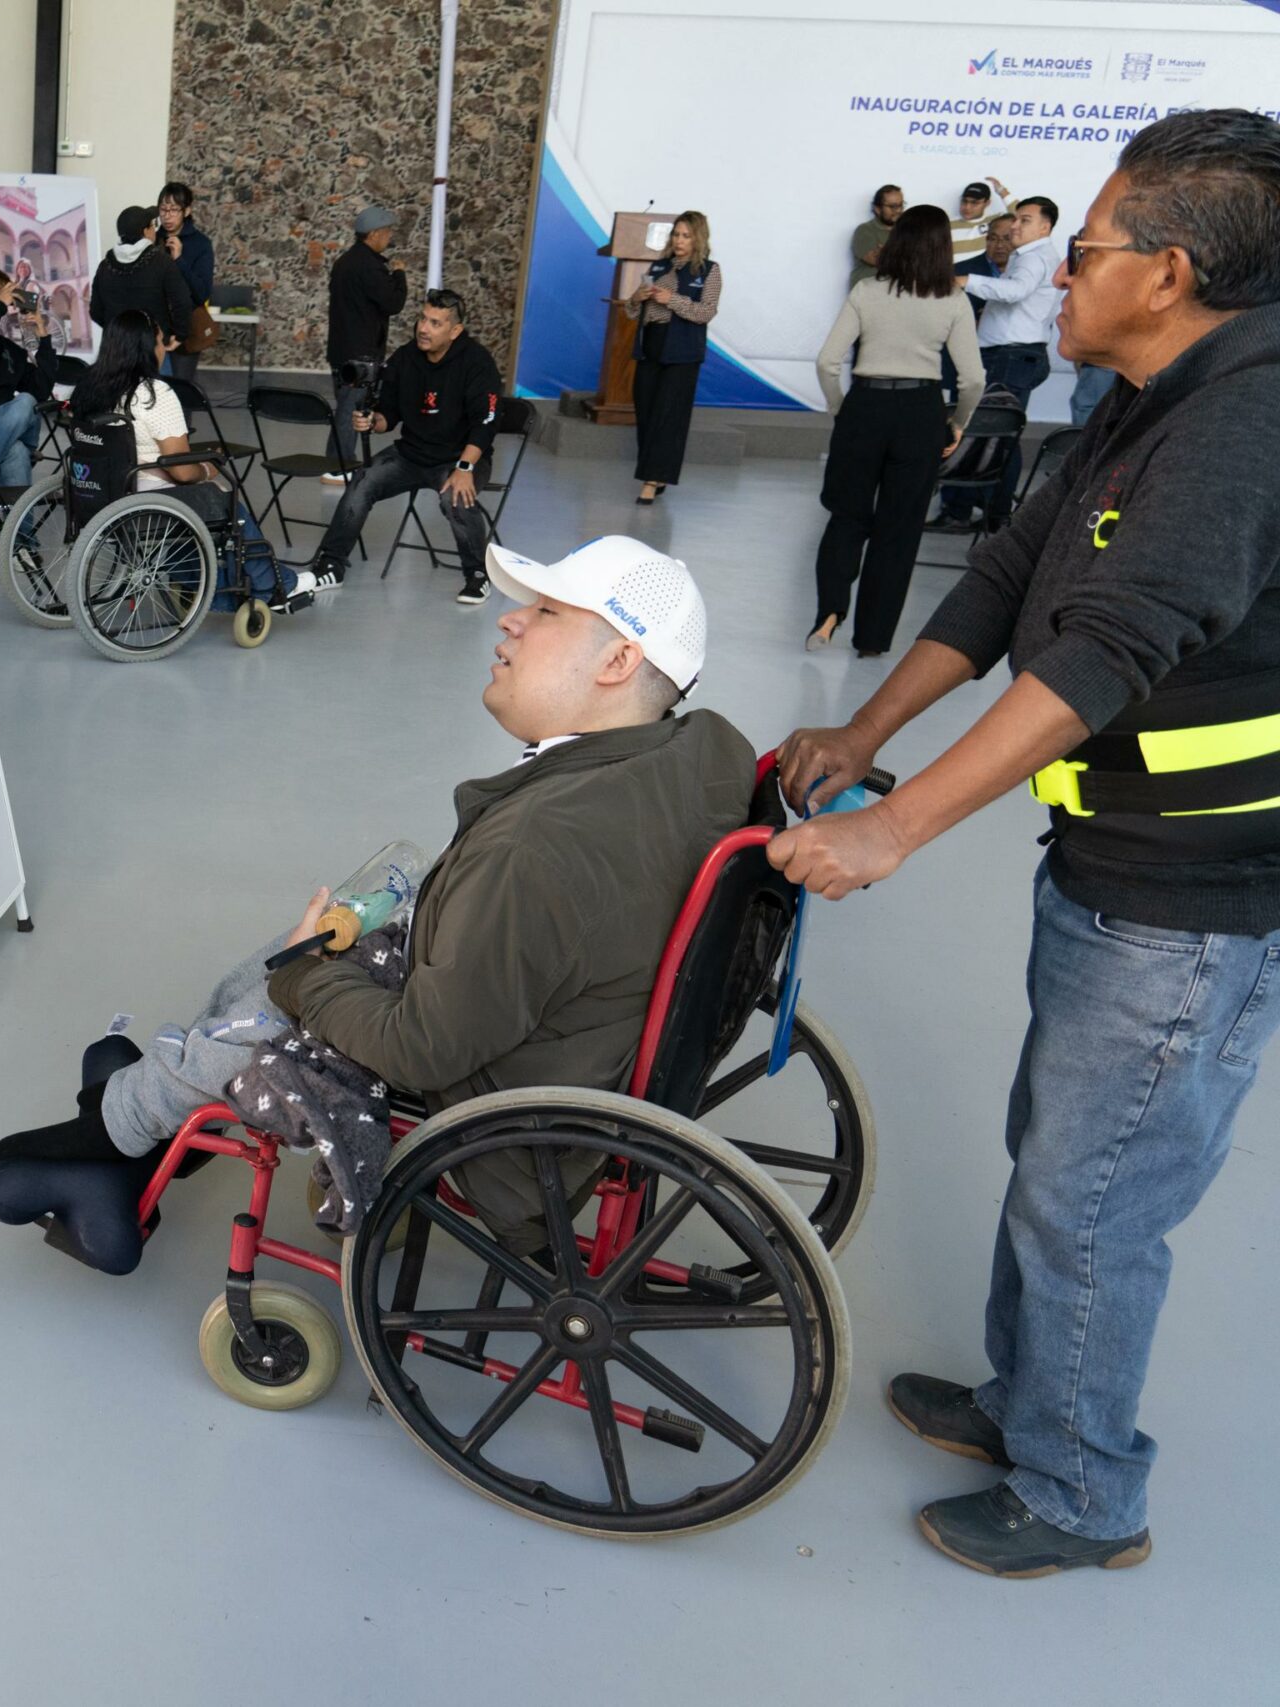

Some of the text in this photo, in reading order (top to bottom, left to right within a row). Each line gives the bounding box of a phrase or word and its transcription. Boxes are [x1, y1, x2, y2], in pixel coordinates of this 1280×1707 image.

[1002, 57, 1093, 70] EL MARQUÉS
[850, 96, 1002, 115] INAUGURACIÓN
[1008, 102, 1035, 116] DE
[1040, 104, 1065, 118] LA
[1073, 103, 1158, 121] GALERÍA
[908, 121, 949, 136] POR
[955, 123, 983, 137] UN
[989, 122, 1109, 142] QUERÉTARO
[604, 597, 647, 637] Keuka
